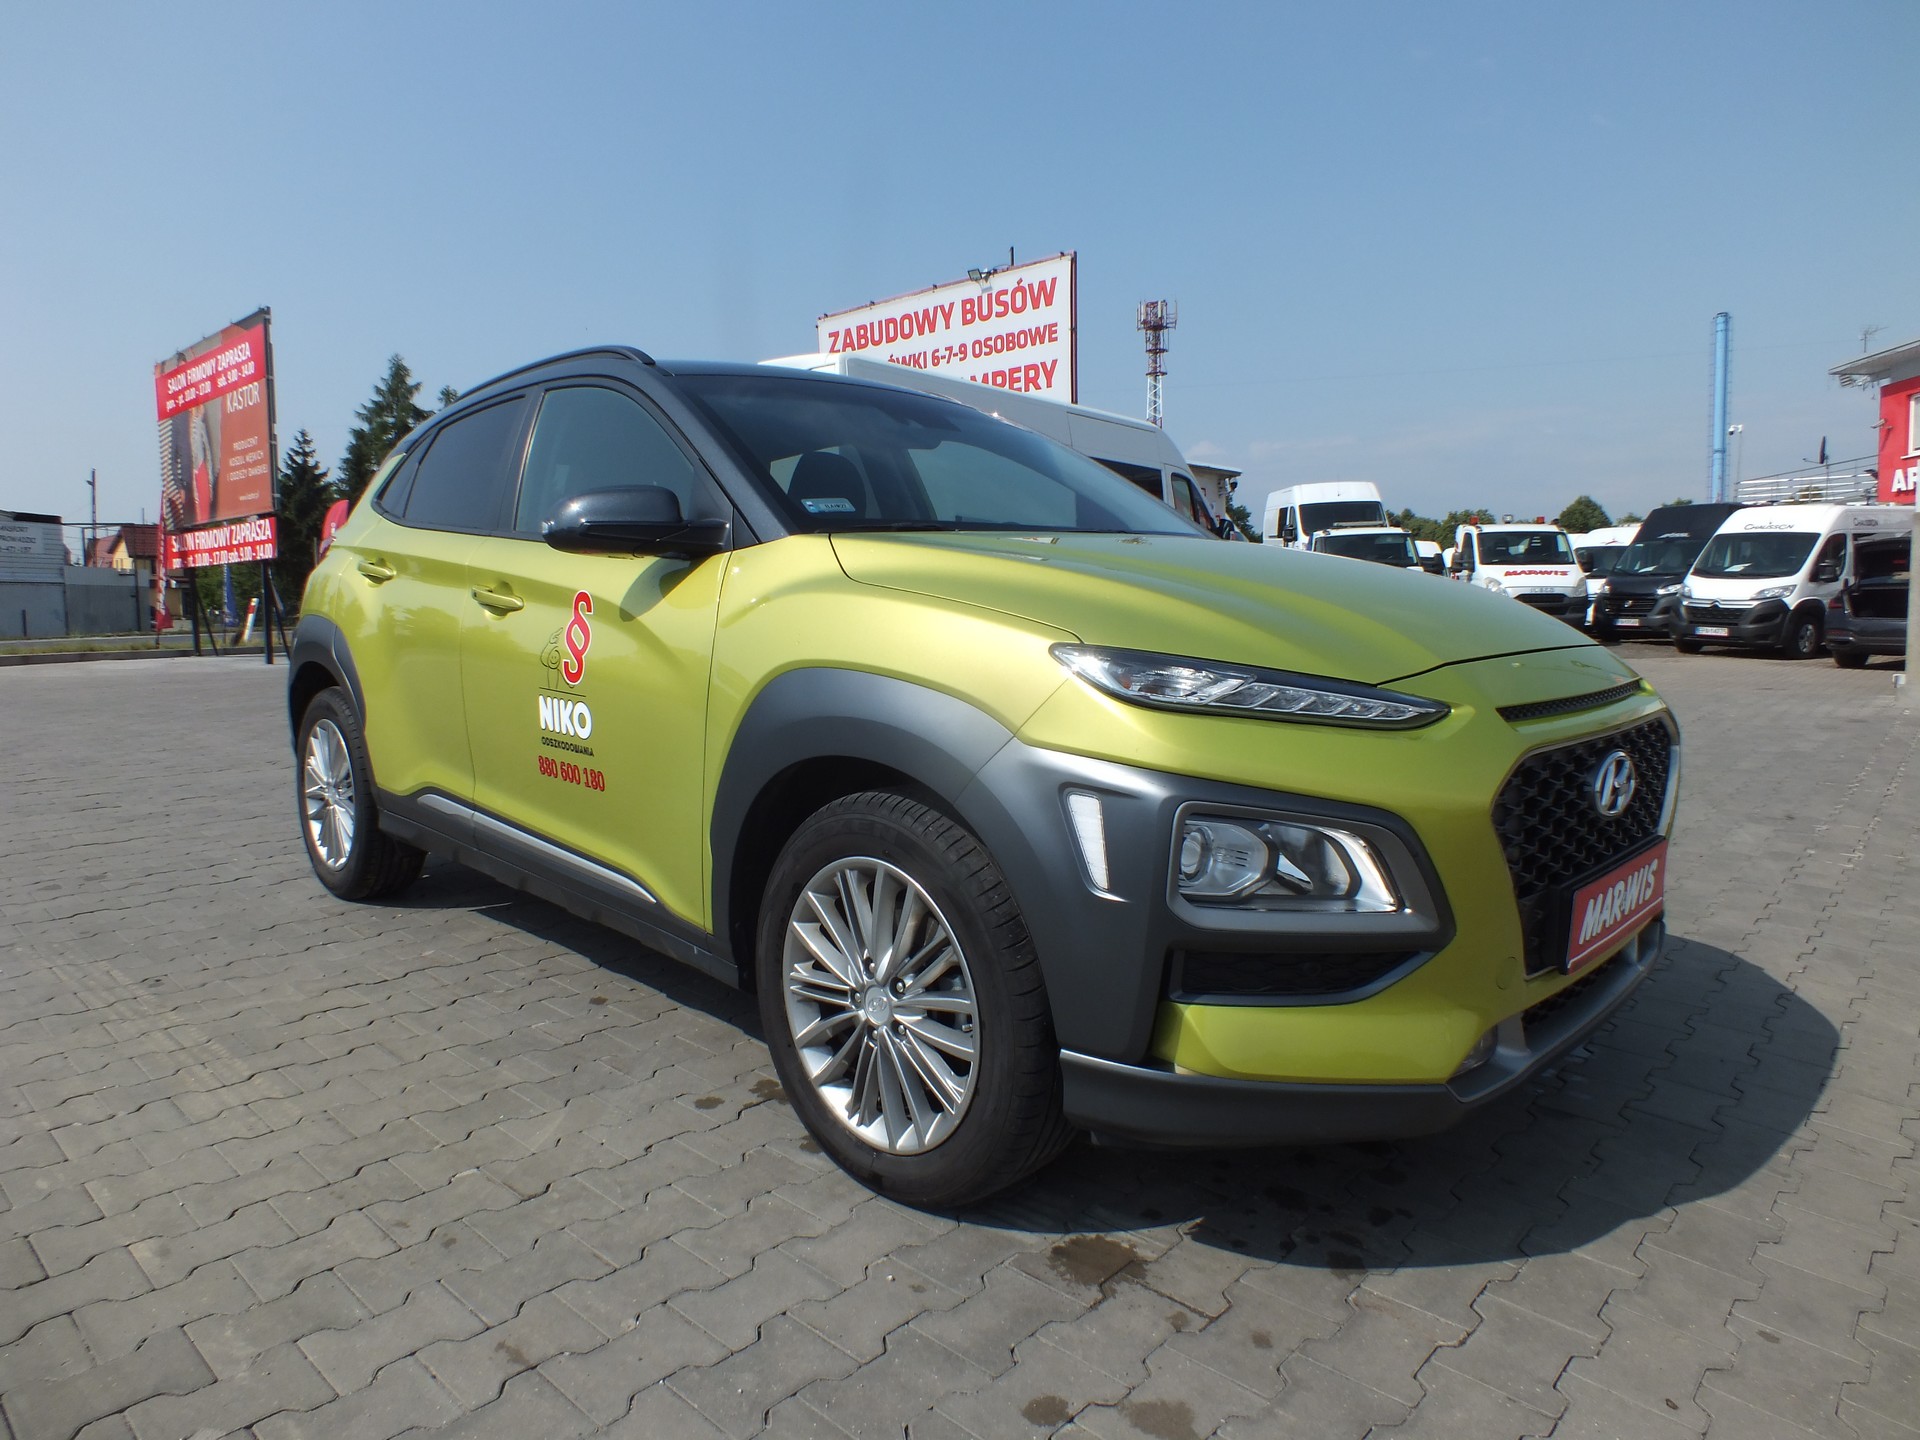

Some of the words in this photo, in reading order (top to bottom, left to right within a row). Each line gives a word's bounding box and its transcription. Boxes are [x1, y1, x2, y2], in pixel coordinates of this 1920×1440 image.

[828, 302, 955, 353] ZABUDOWY
[961, 277, 1058, 326] BUSÓW
[931, 348, 968, 367] 6-7-9
[971, 323, 1058, 359] OSOBOWE
[168, 372, 187, 395] SALON
[187, 358, 216, 385] FIRMOWY
[217, 342, 251, 371] ZAPRASZA
[226, 382, 260, 414] KASTOR
[172, 533, 195, 552] SALON
[195, 526, 230, 550] FIRMOWY
[231, 519, 272, 545] ZAPRASZA
[538, 694, 592, 740] NIKO
[541, 736, 595, 757] ODSZKODOWANIA
[538, 755, 558, 779] 880
[559, 761, 581, 785] 600
[583, 767, 606, 792] 180
